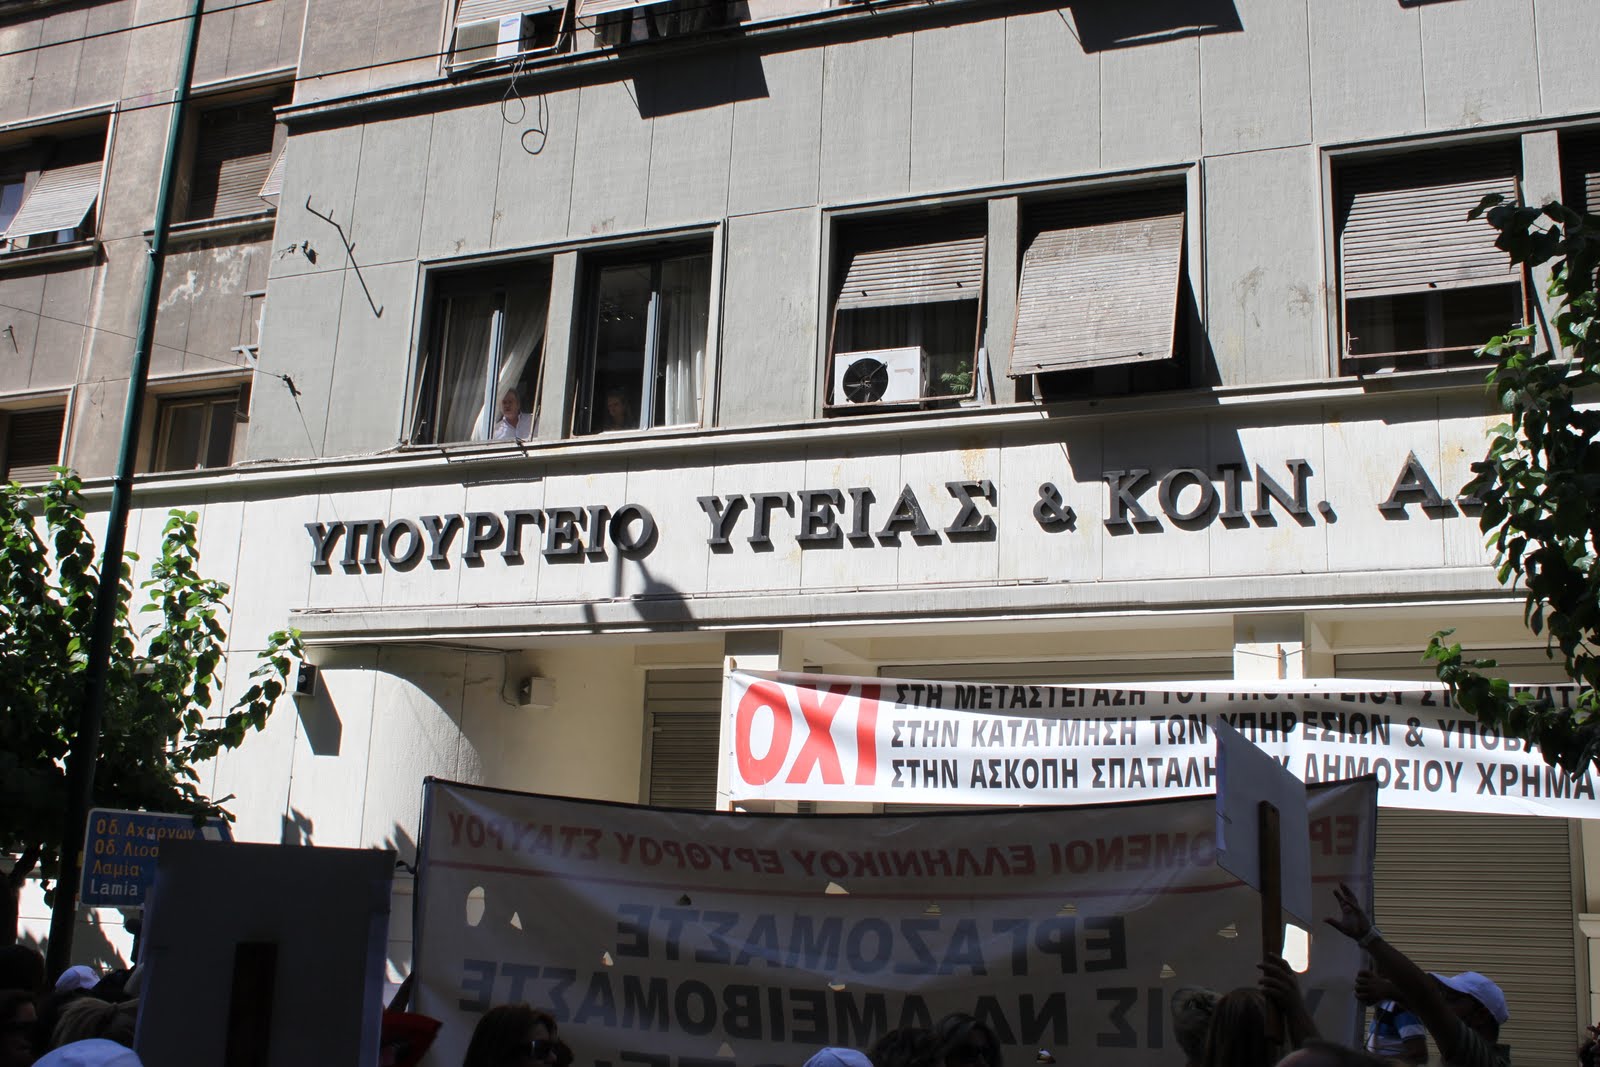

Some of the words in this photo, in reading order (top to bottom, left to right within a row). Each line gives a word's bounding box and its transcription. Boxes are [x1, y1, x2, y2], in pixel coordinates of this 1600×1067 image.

[304, 503, 657, 568] ΥΠΟΥΡΓΕΙΟ
[697, 479, 994, 545] ΥΓΕΙΑΣ
[1033, 481, 1073, 525] &
[1102, 458, 1331, 525] ΚΟΙΝ.
[894, 683, 943, 709] ΣΤΗ
[735, 681, 881, 786] ΟΧΙ
[891, 719, 960, 748] ΣΤΗΝ
[970, 716, 1137, 748] ΚΑΤΑΤΜΗΣΗ
[1150, 713, 1208, 745] ΤΩΝ
[1405, 717, 1426, 748] &
[891, 758, 959, 789] ΣΤΗΝ
[970, 758, 1079, 790] ΑΣΚΟΠΗ
[1475, 761, 1600, 801] ΧΡΗΜΑ
[96, 818, 121, 835] Οδ.
[123, 841, 160, 857] Λιοσ
[92, 859, 140, 878] Λαμία
[90, 878, 138, 896] Lamia
